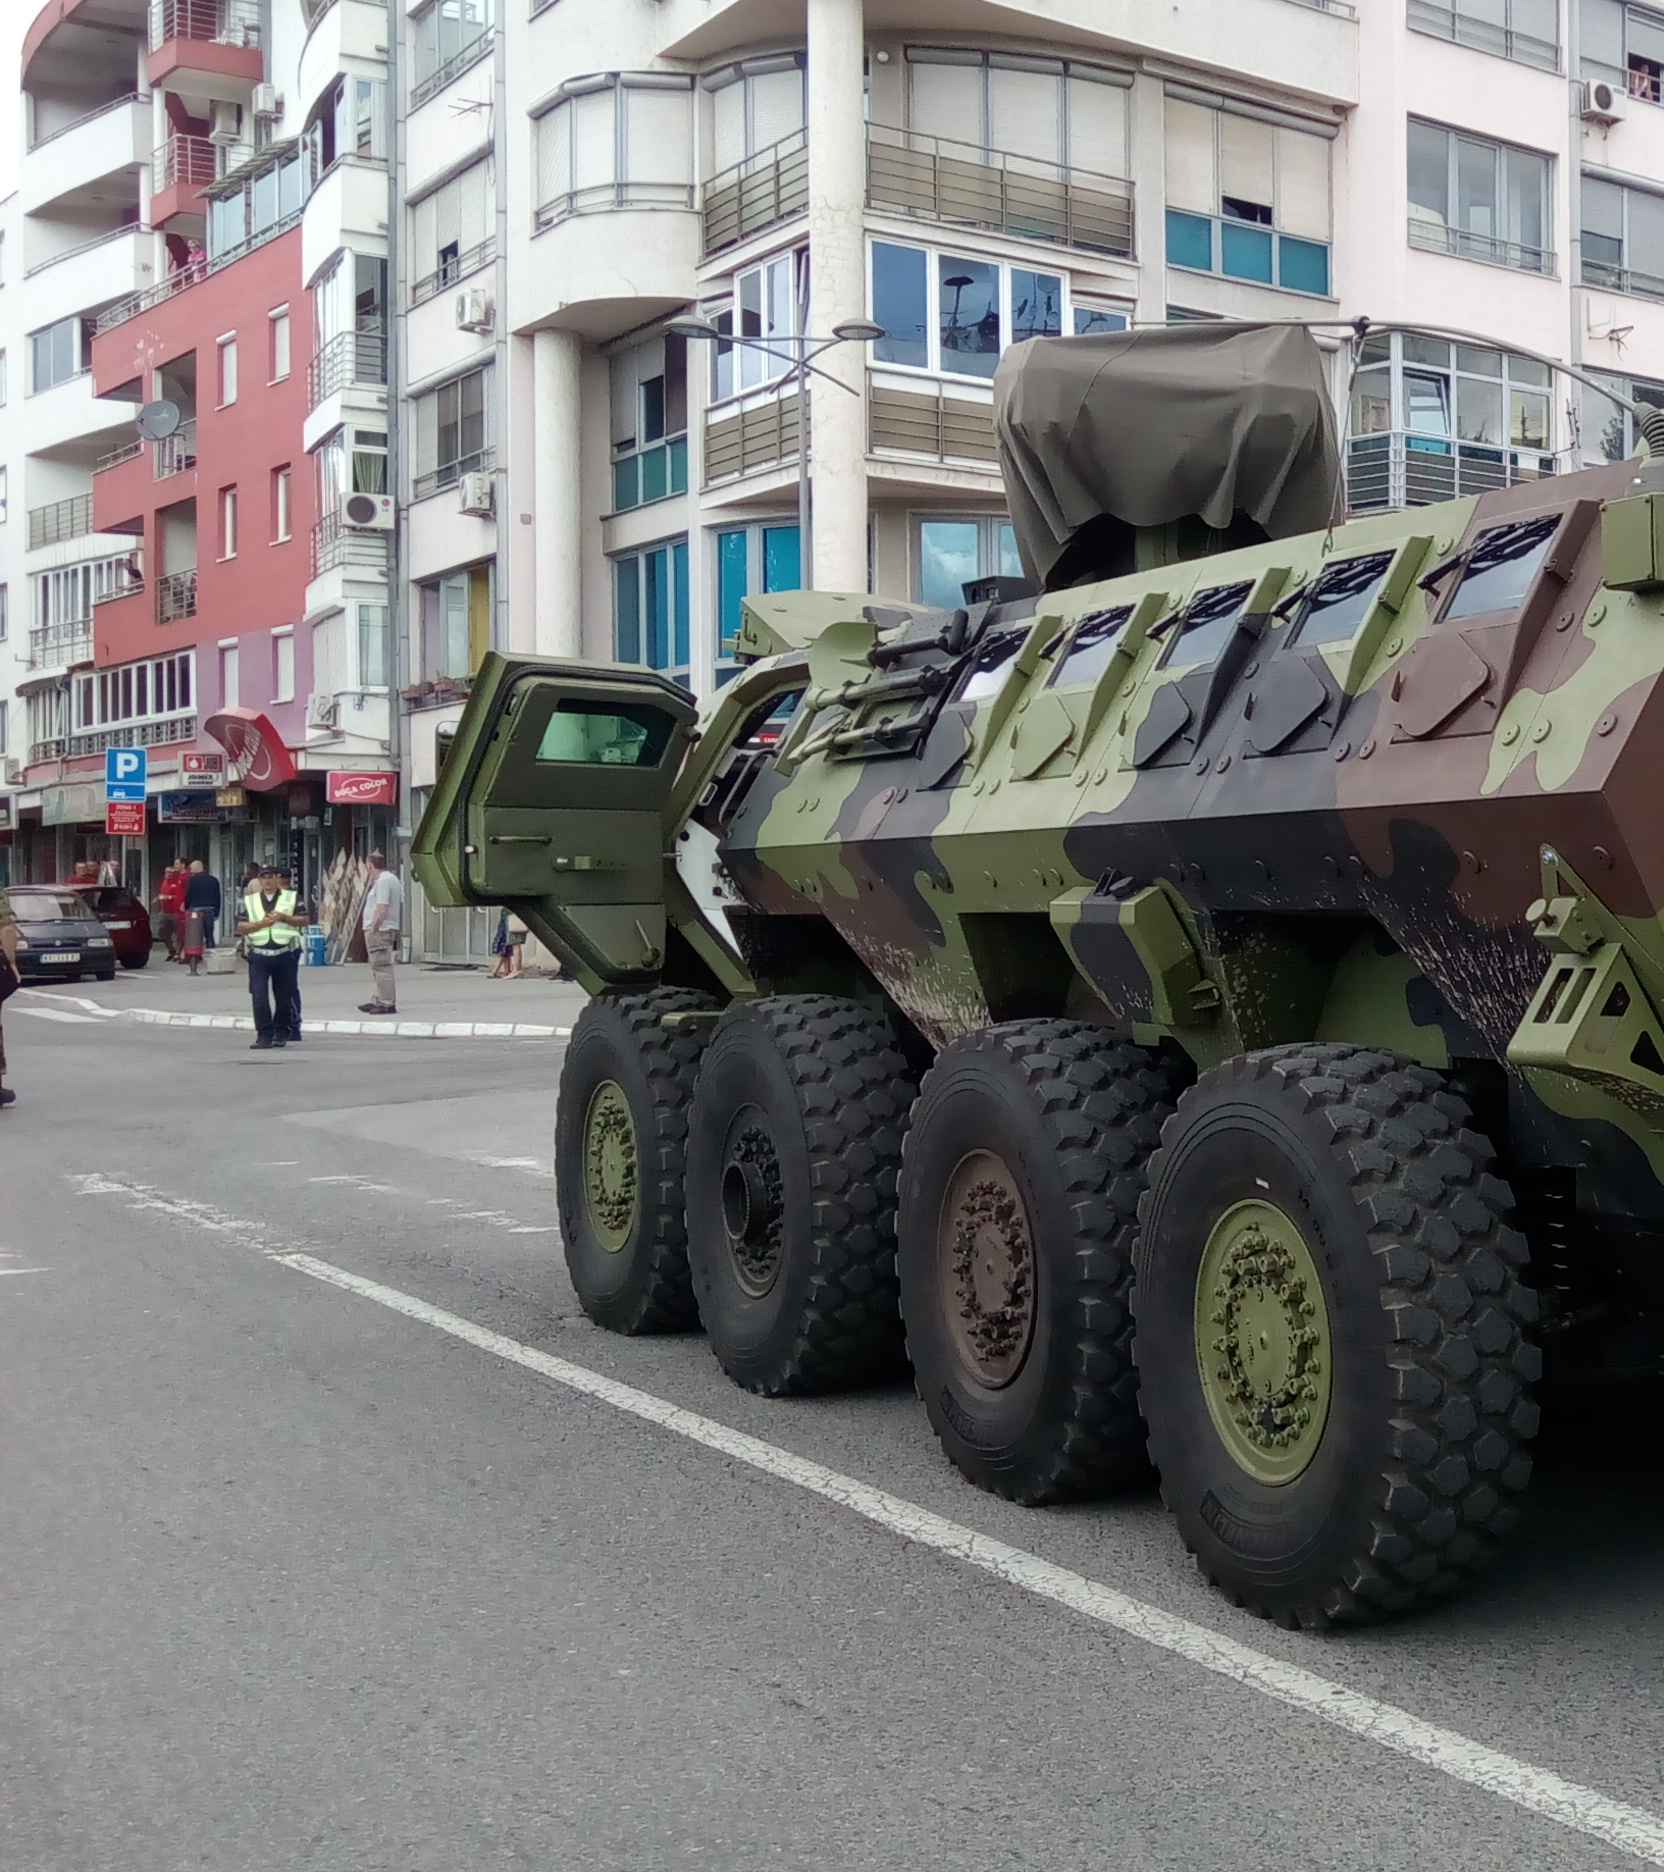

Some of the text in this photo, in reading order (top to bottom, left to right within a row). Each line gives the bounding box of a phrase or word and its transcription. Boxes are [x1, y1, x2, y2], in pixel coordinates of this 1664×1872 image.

[116, 753, 138, 779] P
[334, 778, 388, 798] DUGA COLOR
